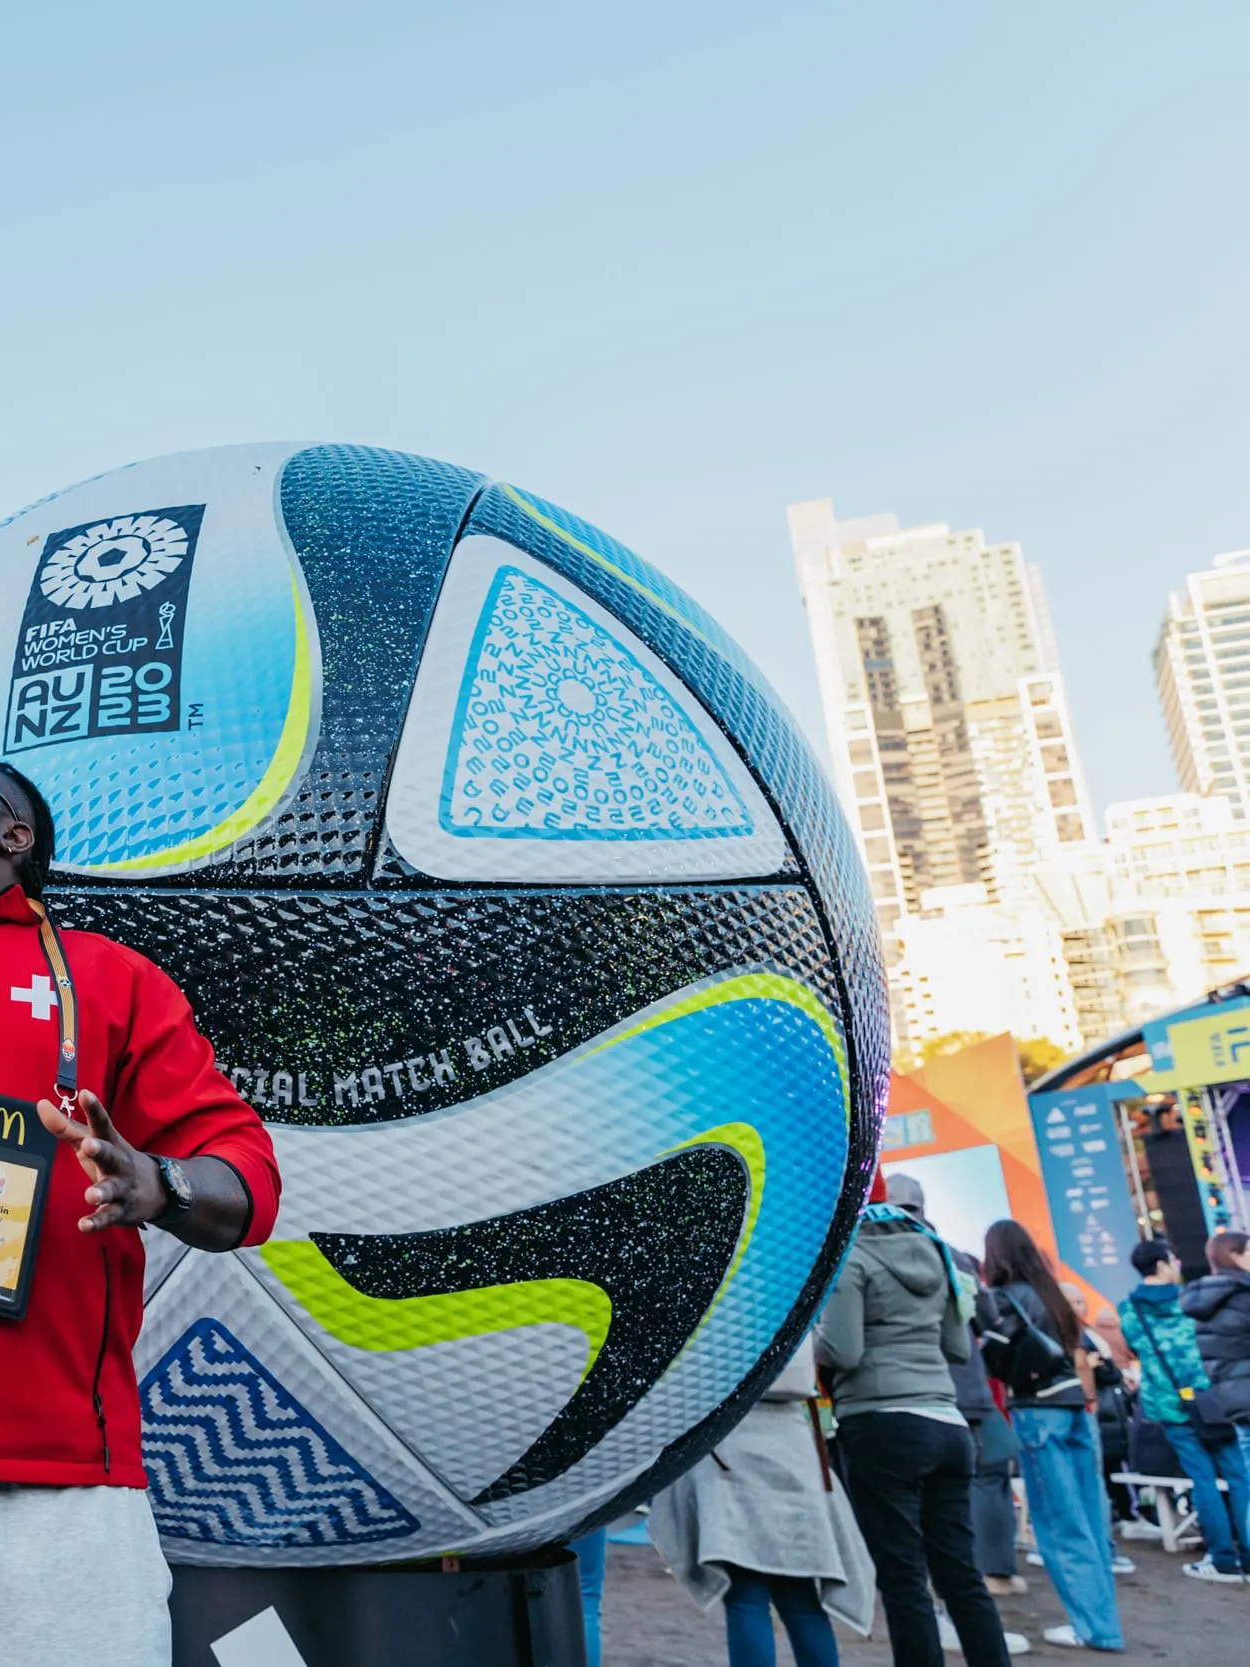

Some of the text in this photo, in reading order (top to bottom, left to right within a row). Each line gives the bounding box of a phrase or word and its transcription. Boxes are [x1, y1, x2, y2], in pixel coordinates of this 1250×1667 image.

[24, 624, 127, 657] WOMEN'S
[26, 618, 76, 642] FIFA
[21, 636, 149, 672] WORLD CUP
[18, 672, 85, 711] AU
[100, 661, 173, 696] 20
[14, 703, 82, 743] NZ
[97, 692, 172, 728] 23
[187, 702, 205, 731] TM
[214, 1005, 554, 1107] CIAL MATCH BALL
